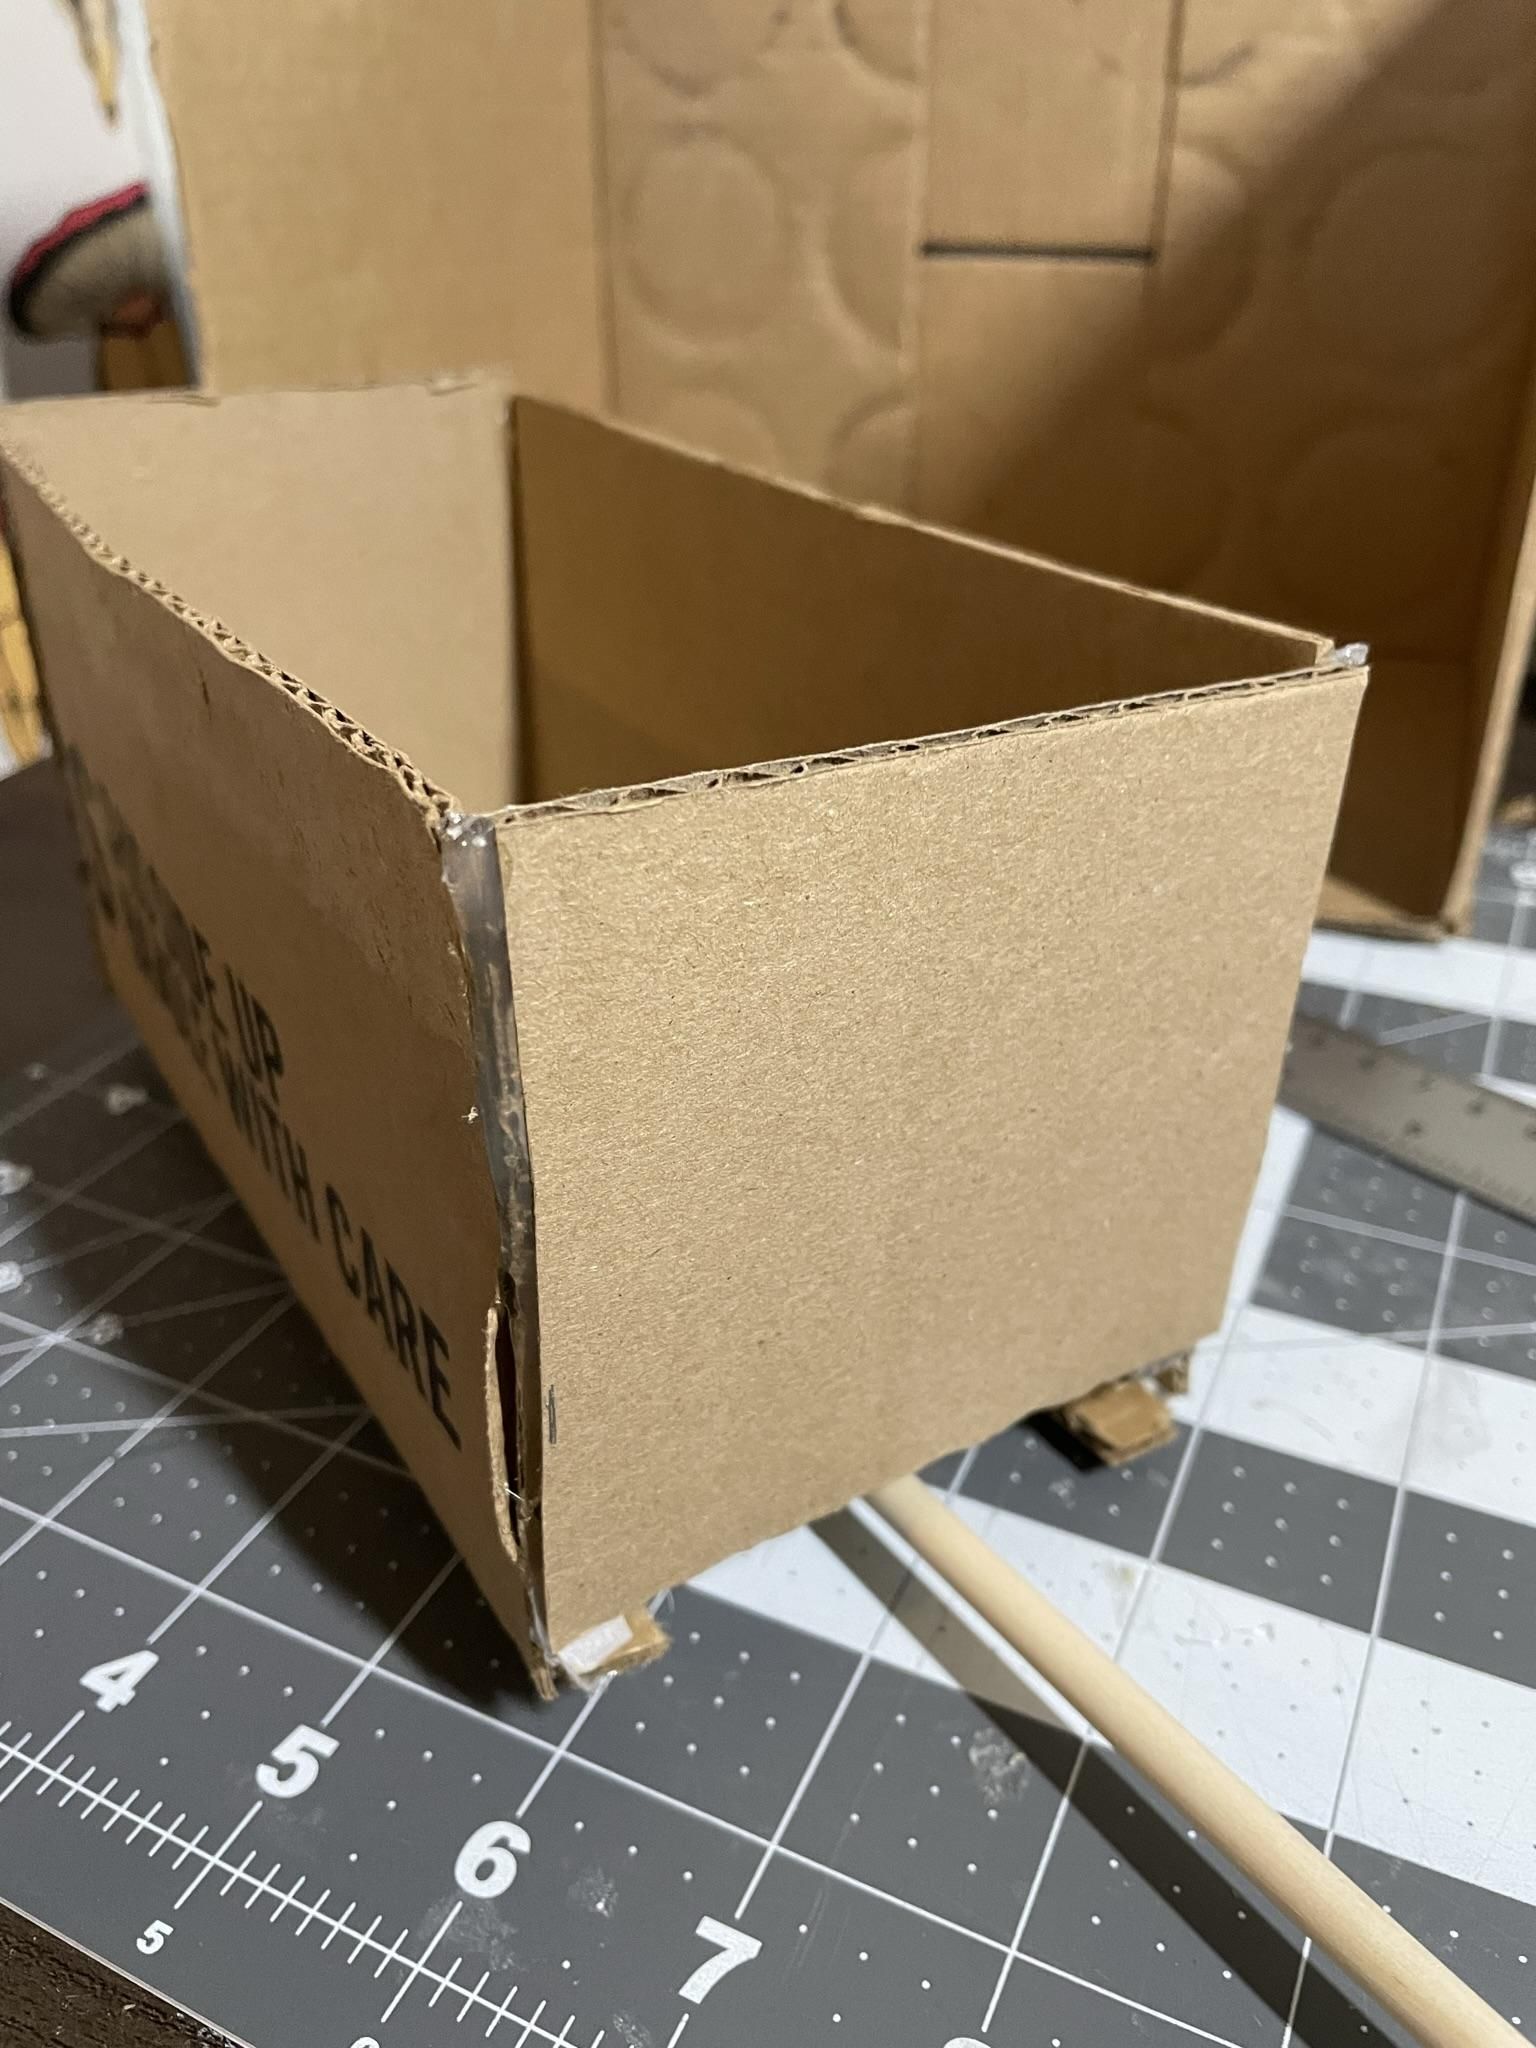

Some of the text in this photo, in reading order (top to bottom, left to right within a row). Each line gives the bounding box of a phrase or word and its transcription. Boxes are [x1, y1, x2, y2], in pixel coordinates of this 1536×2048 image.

[224, 962, 284, 1107] UP
[212, 1029, 463, 1453] WITH CARE
[79, 1650, 159, 1712] 4
[255, 1724, 340, 1798] 5
[454, 1820, 531, 1899] 6
[136, 1920, 174, 1955] 5
[678, 1915, 763, 2005] 7
